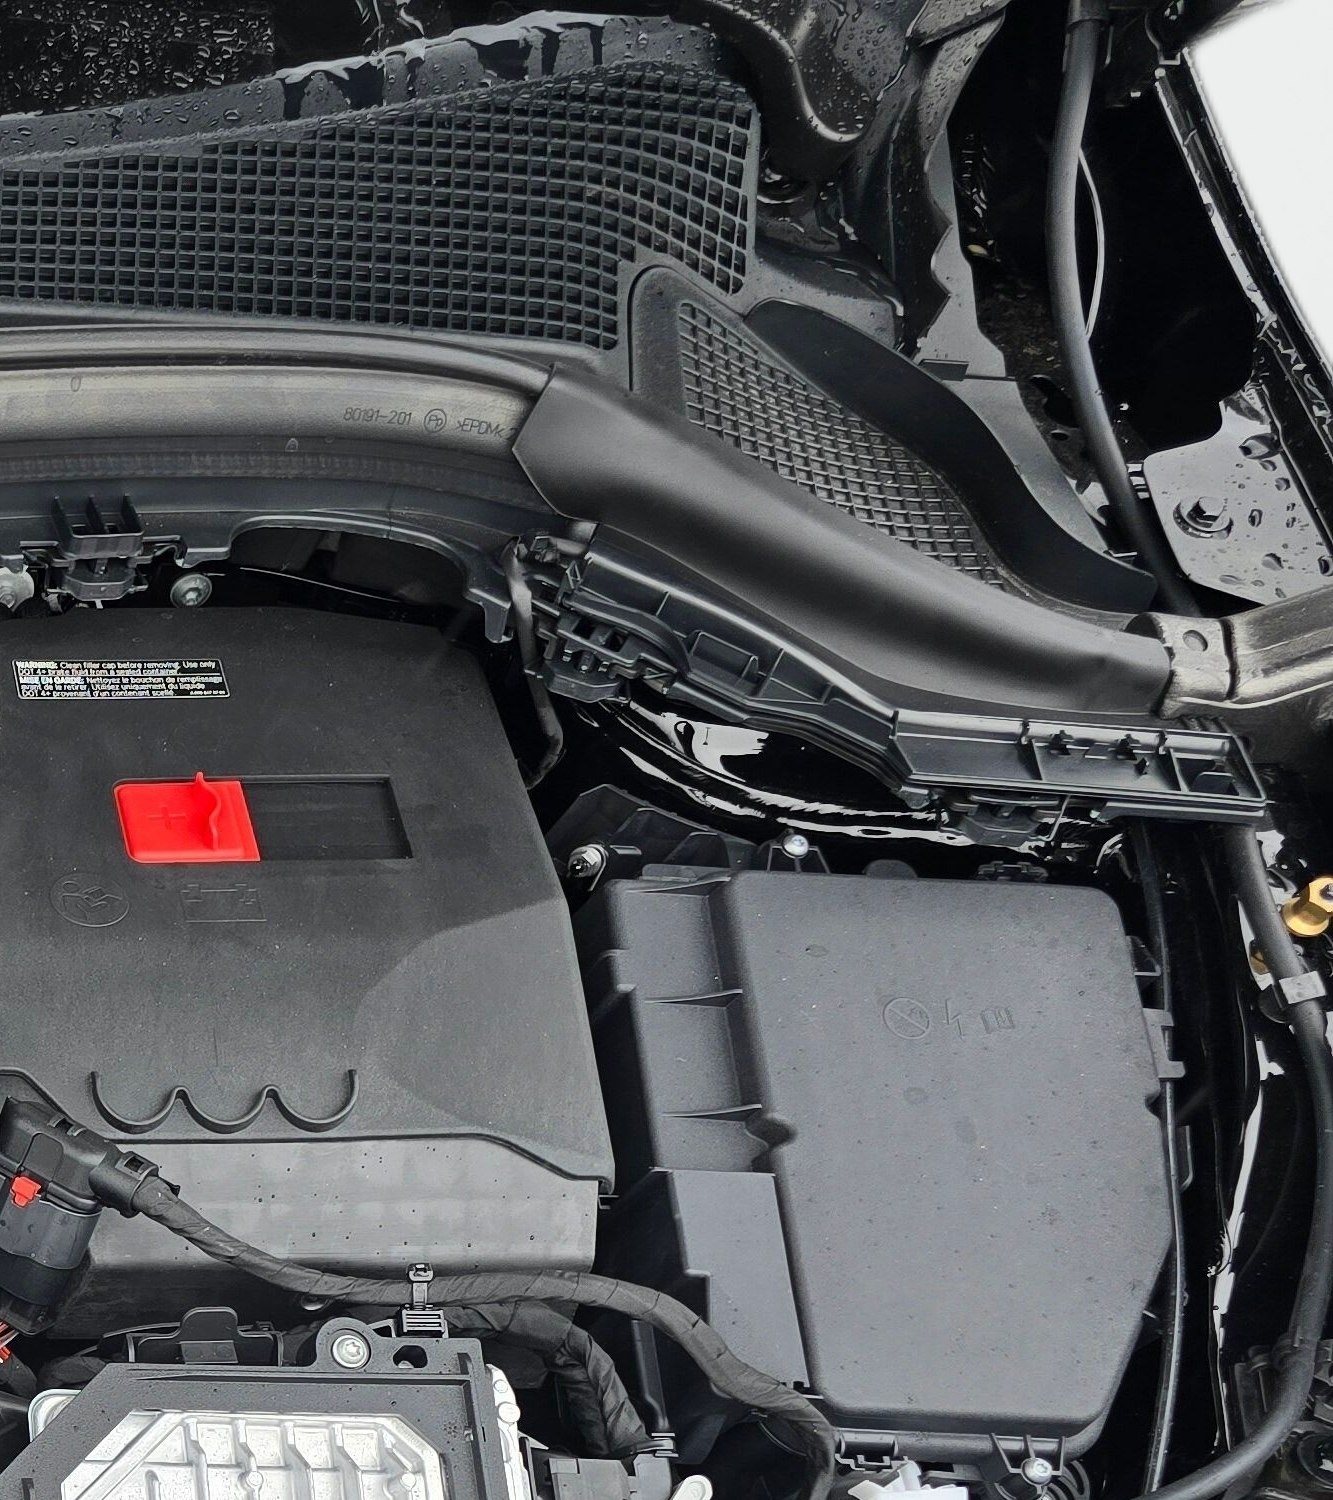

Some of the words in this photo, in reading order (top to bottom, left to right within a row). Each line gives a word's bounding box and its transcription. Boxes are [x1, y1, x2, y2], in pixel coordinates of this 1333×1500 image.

[343, 407, 412, 426] 80191-201
[60, 661, 82, 669] Clean
[102, 662, 116, 670] cap
[117, 661, 143, 669] before
[183, 661, 198, 669] Use
[200, 661, 215, 670] only
